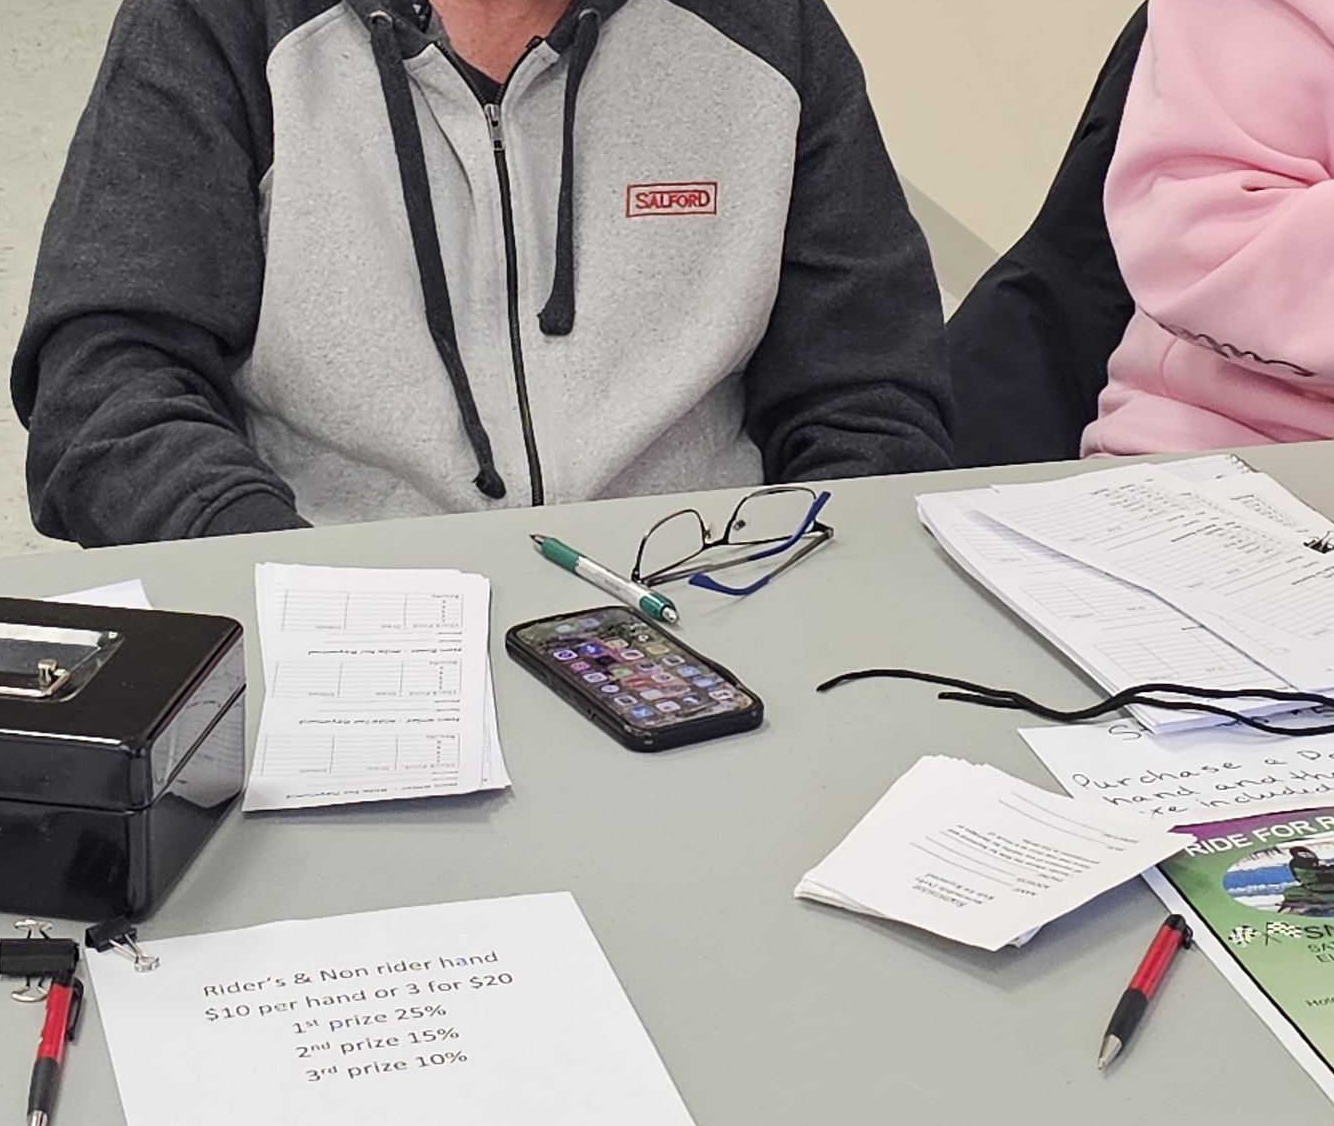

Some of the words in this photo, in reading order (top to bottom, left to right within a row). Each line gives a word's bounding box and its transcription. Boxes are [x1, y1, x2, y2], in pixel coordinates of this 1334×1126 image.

[636, 190, 710, 209] SALFORD
[1184, 829, 1251, 857] RIDE
[1256, 819, 1312, 844] FOR
[203, 976, 286, 997] Rider's
[294, 973, 313, 984] &
[320, 965, 369, 983] Non
[377, 958, 433, 975] rider
[439, 951, 498, 969] hand
[204, 1004, 251, 1022] $10
[258, 999, 298, 1017] per
[306, 990, 366, 1008] hand
[374, 987, 399, 1000] or
[407, 983, 421, 995] 3
[428, 978, 462, 993] for
[469, 973, 513, 989] $20
[329, 1012, 388, 1032] prize
[395, 1004, 447, 1020] 25%
[341, 1035, 400, 1056] prize
[408, 1027, 459, 1044] 15%
[347, 1059, 408, 1079] prize
[416, 1050, 468, 1067] 10%
